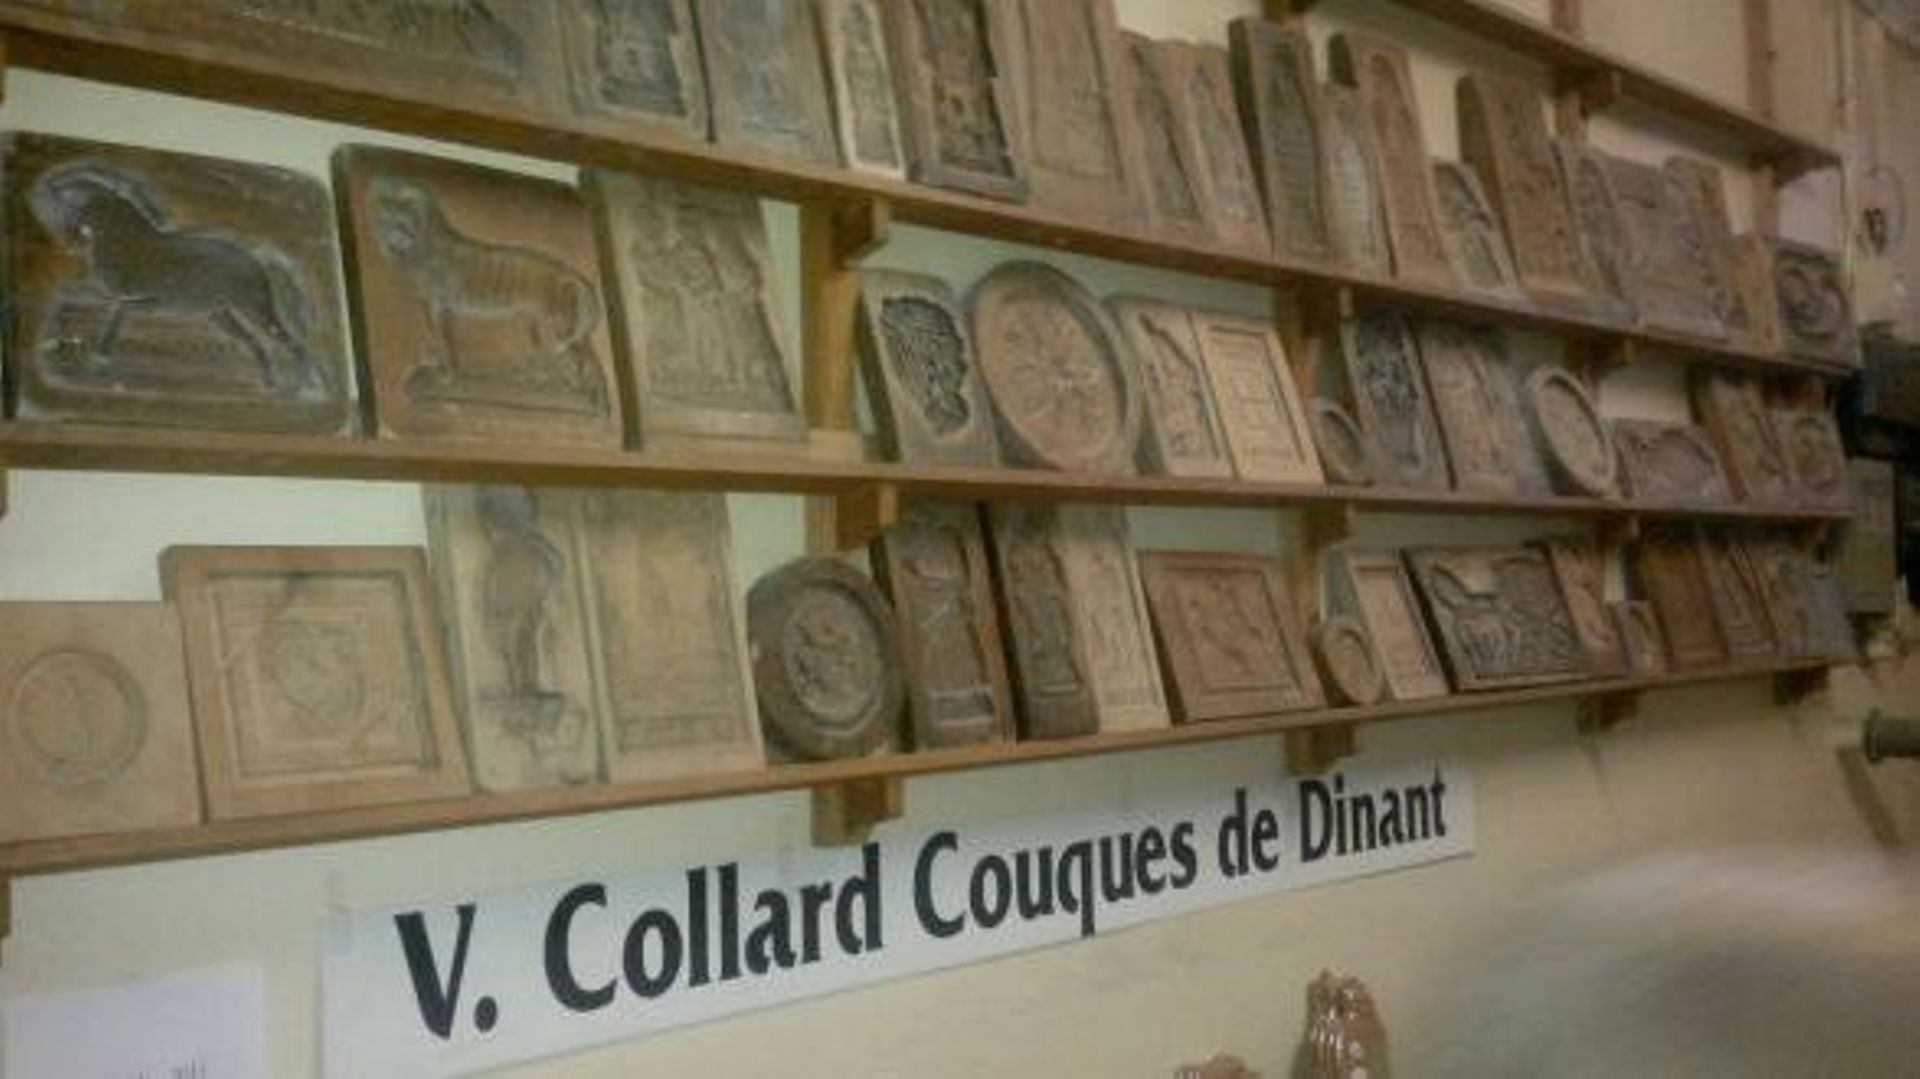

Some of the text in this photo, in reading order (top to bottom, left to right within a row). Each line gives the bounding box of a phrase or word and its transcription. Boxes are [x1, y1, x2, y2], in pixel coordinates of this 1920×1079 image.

[394, 767, 1447, 1039] V. Collard Couques de Dinant
